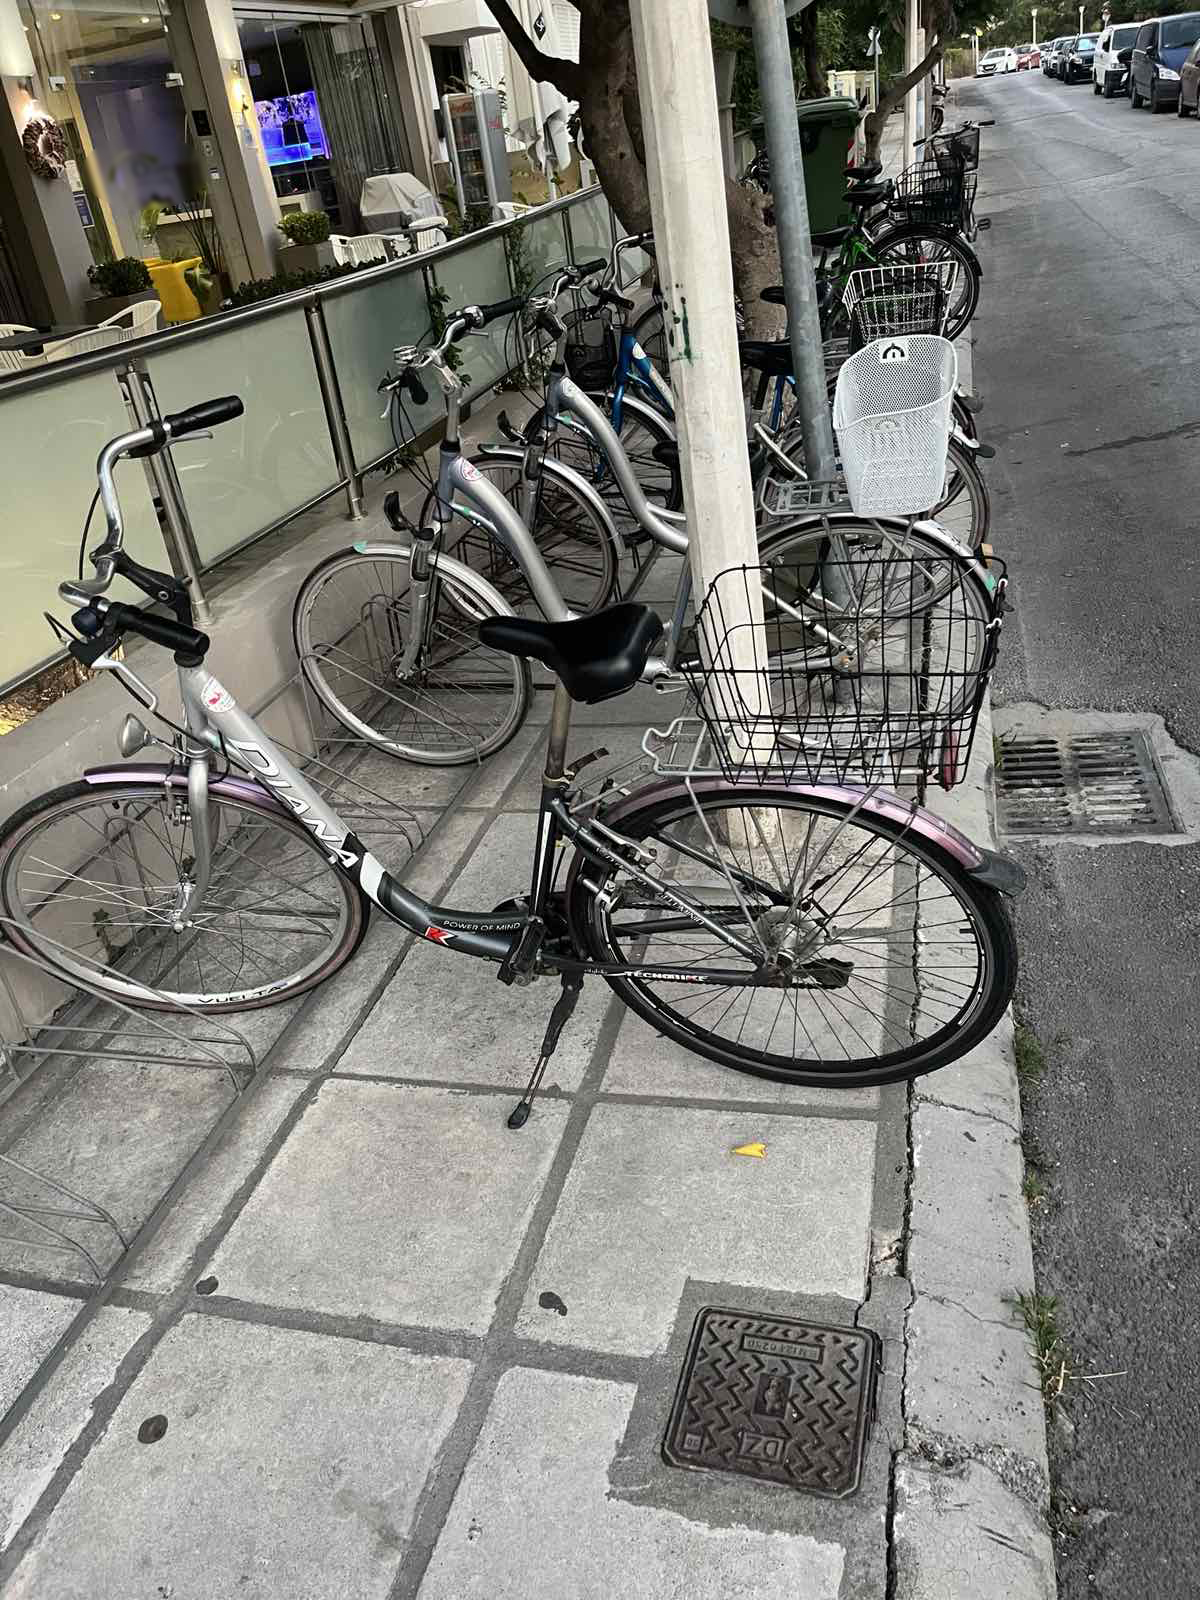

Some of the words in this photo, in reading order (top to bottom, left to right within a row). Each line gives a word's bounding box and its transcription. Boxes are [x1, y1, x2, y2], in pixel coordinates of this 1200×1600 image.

[230, 739, 360, 869] DIANA
[442, 920, 478, 931] POWER
[496, 922, 521, 931] MIND
[624, 969, 710, 983] TECNOBIKE
[197, 985, 281, 1004] VUELTA
